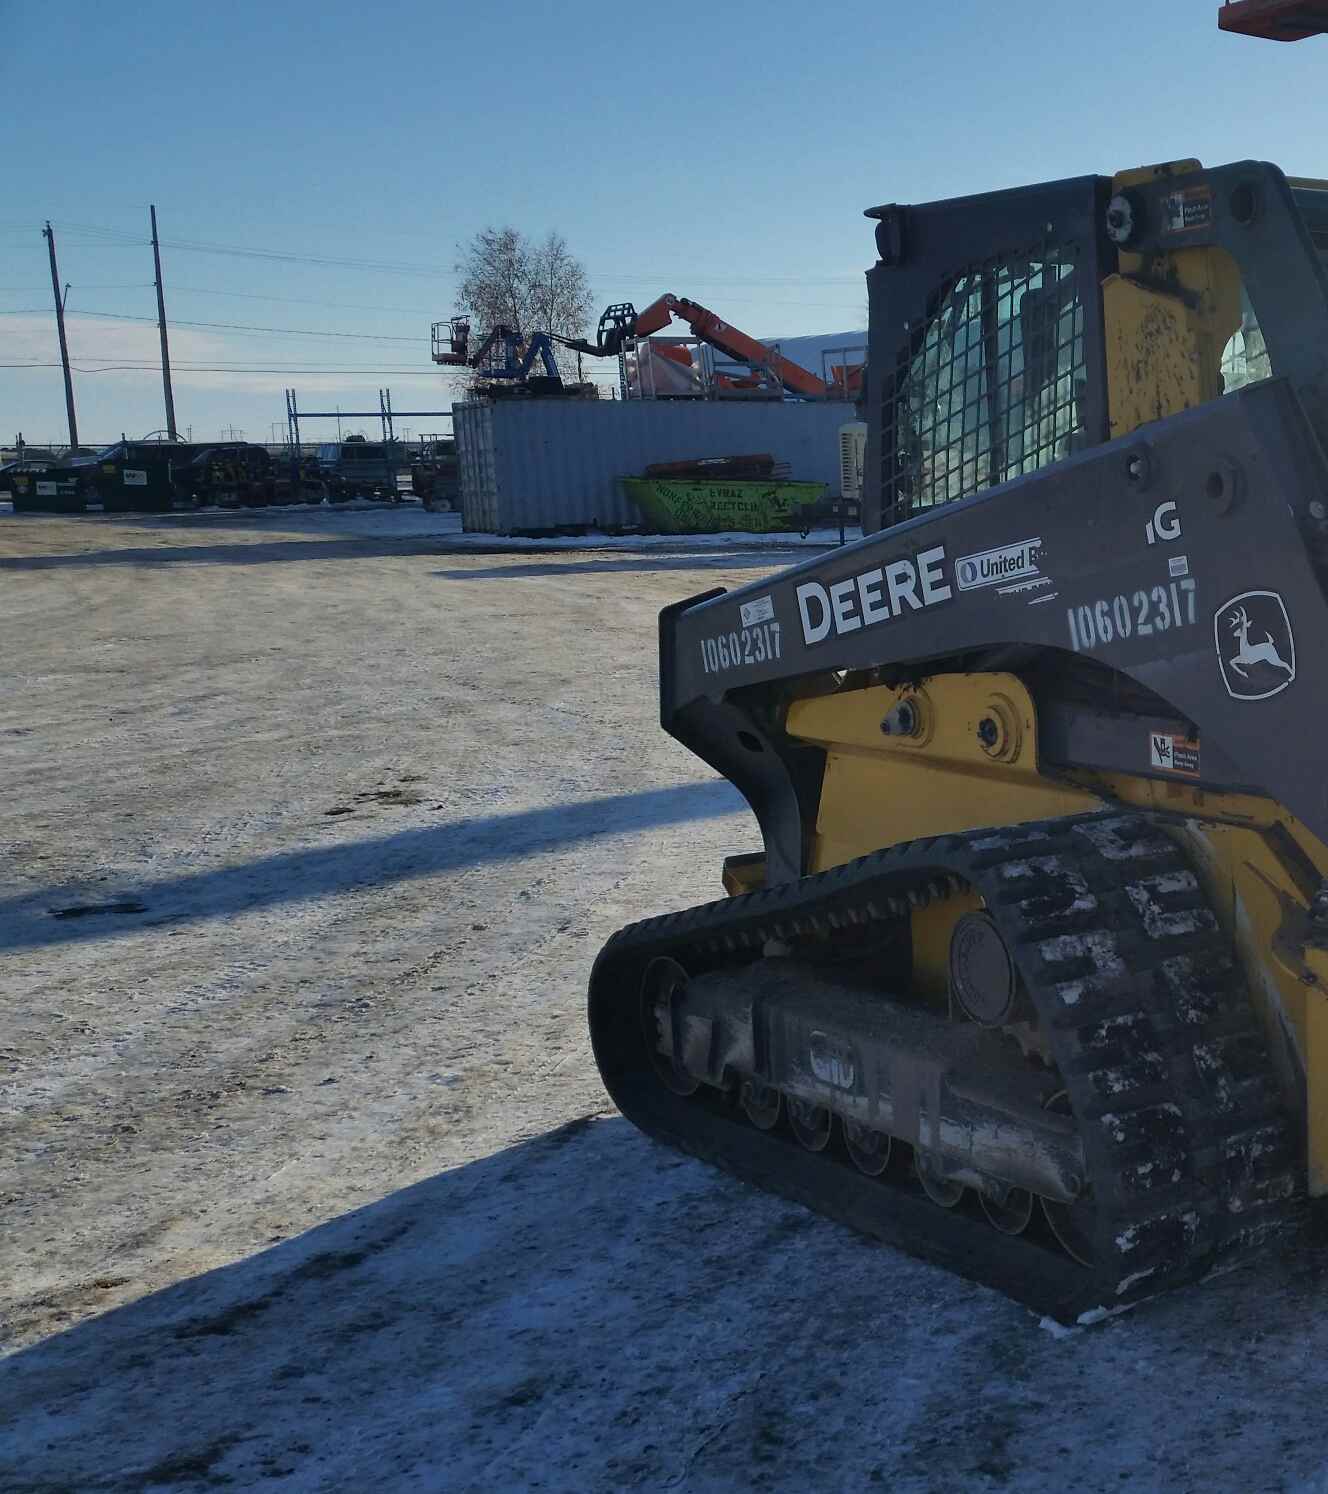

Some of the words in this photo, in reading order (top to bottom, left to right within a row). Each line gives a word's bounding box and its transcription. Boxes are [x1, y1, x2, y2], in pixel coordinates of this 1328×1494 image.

[980, 549, 1025, 578] United
[796, 546, 952, 645] DEERE
[1067, 578, 1197, 651] 10602317
[700, 622, 781, 673] 10602317
